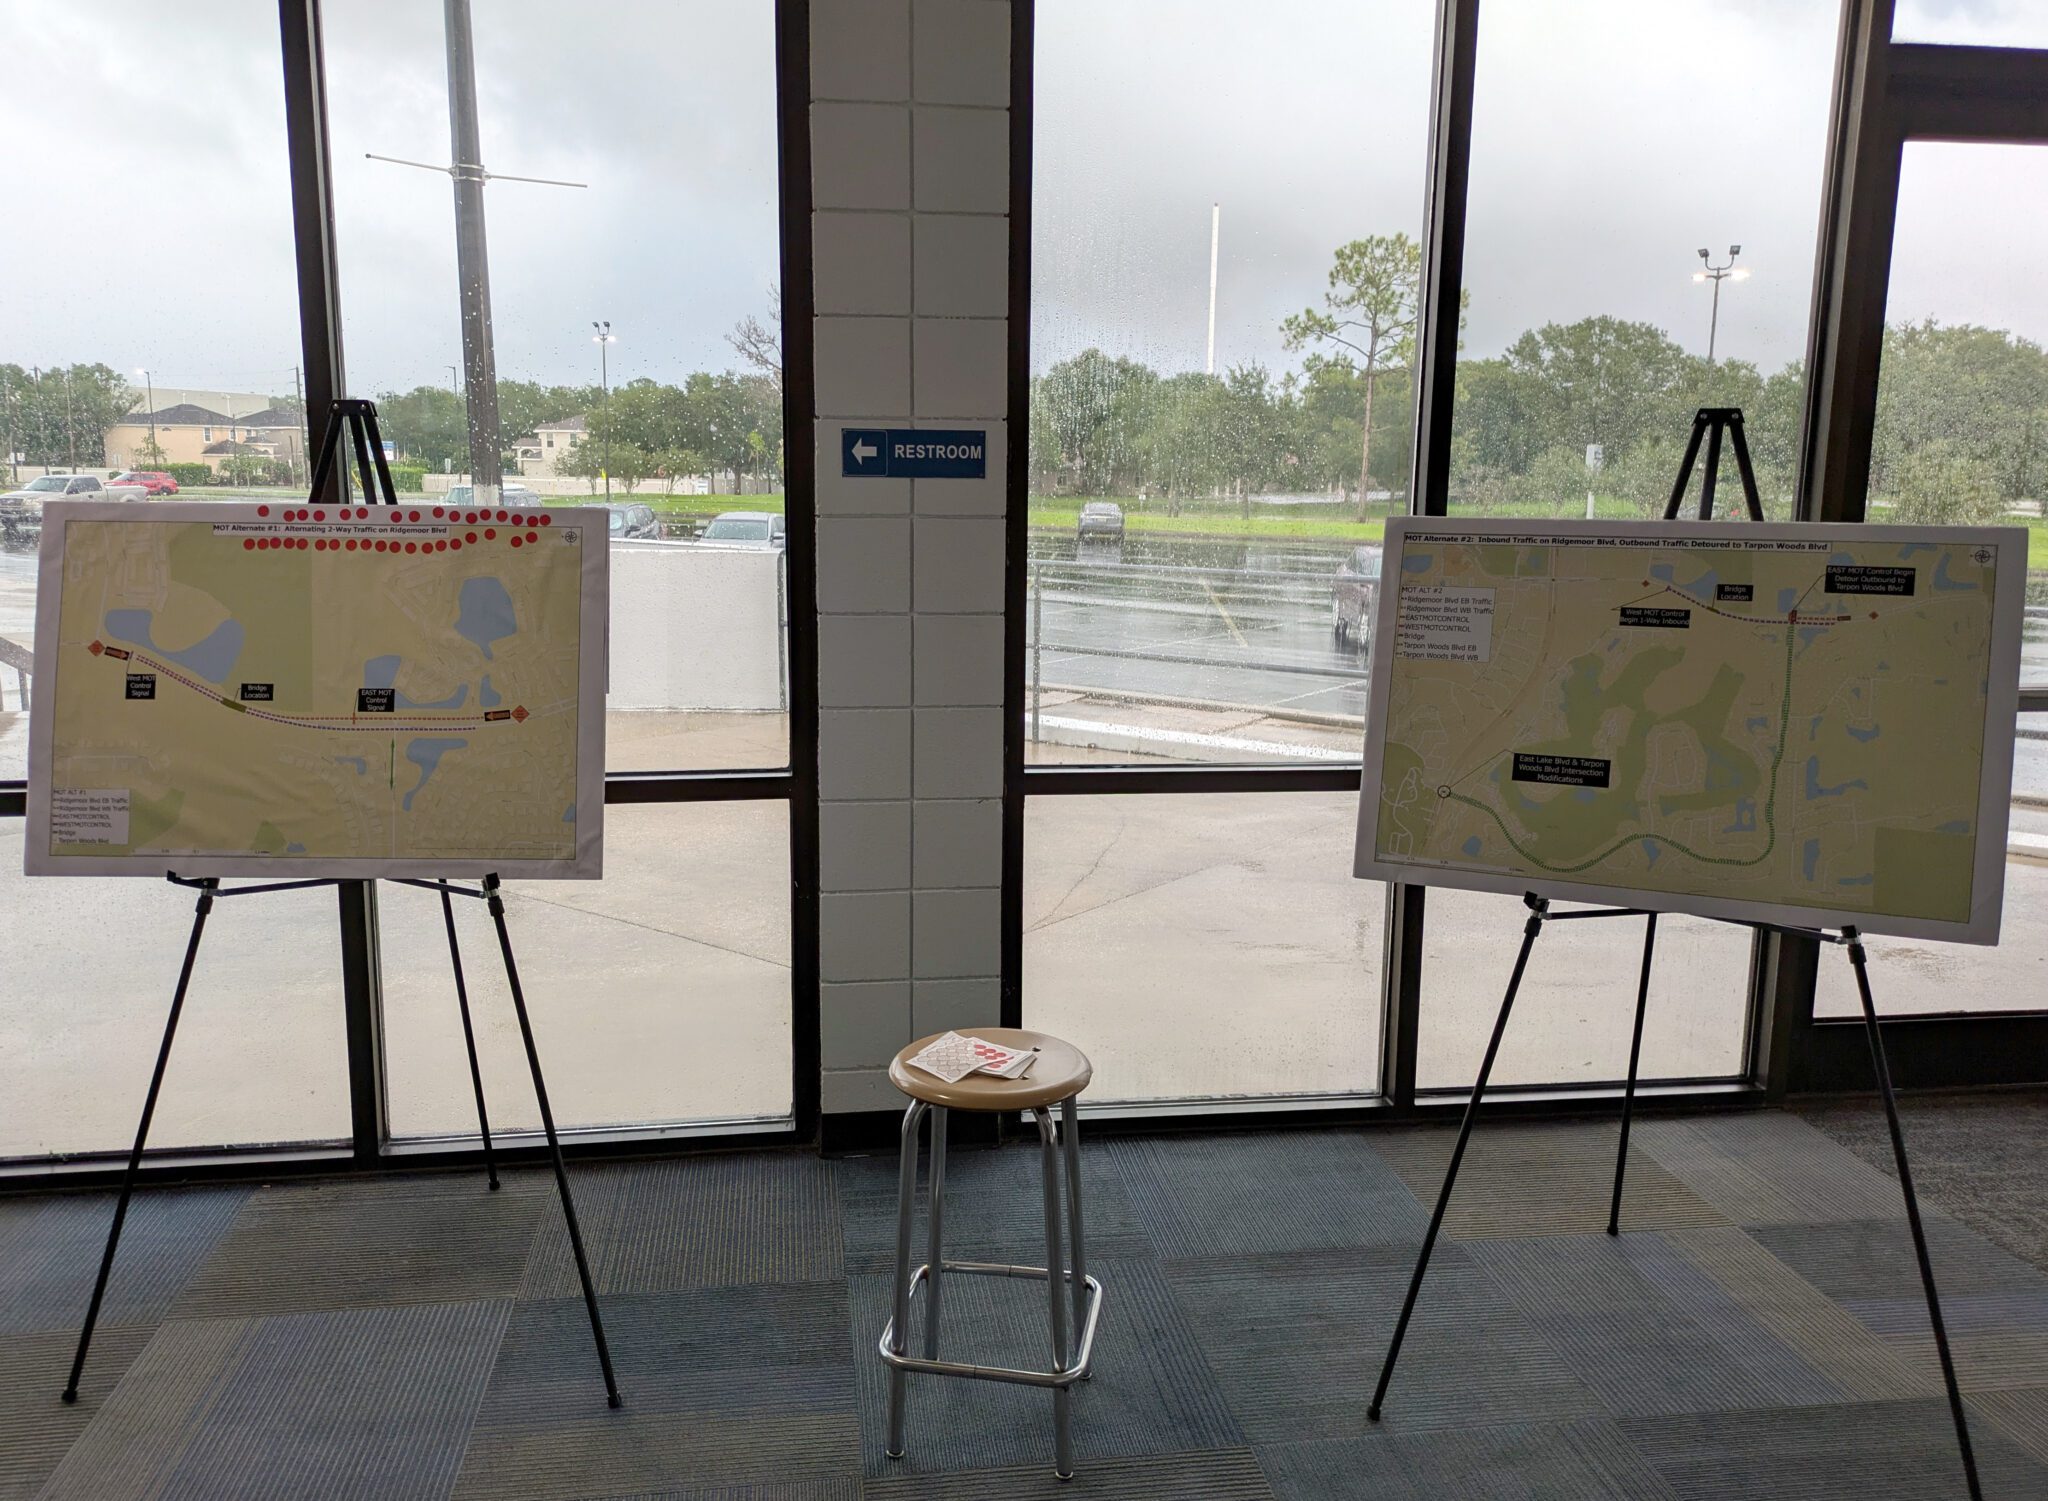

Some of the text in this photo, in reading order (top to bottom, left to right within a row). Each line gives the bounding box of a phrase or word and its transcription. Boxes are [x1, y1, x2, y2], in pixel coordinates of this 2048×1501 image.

[894, 444, 982, 460] RESTROOM
[1513, 536, 1537, 544] Traffic
[1551, 537, 1595, 546] Ridgemoor
[1596, 538, 1617, 546] Blvd,
[1619, 539, 1660, 547] Outbound
[1662, 539, 1689, 547] Traffic
[1691, 540, 1730, 548] Detoured
[1744, 541, 1774, 550] Tarpon
[1776, 542, 1806, 550] Woods
[1808, 542, 1828, 550] Blvd
[1893, 568, 1914, 576] Begin
[1835, 575, 1859, 583] Detour
[1860, 576, 1896, 584] Outbound
[1724, 585, 1746, 593] Bridge
[1836, 583, 1904, 592] Tarpon Woods Blvd
[1407, 595, 1442, 604] Ridgemoor
[1444, 596, 1459, 604] Blvd
[1472, 597, 1493, 606] Traffic
[1406, 605, 1441, 614] Ridgemoor
[1474, 607, 1495, 615] Traffic
[1660, 610, 1685, 618] Control
[1405, 614, 1469, 623] EASTMOTCONTROL
[1405, 623, 1471, 632] WESTMOTCONTROL
[1404, 632, 1425, 640] Bridge
[1404, 642, 1477, 652] Tarpon Woods Blvd EB
[1403, 651, 1425, 660] Tarpon
[1426, 652, 1449, 660] Woods
[1536, 756, 1553, 764] Lake
[1555, 757, 1570, 765] Blvd
[1580, 760, 1605, 768] Tarpon
[1519, 764, 1543, 772] Woods
[1561, 767, 1604, 776] Intersection
[1537, 774, 1583, 784] Modifications
